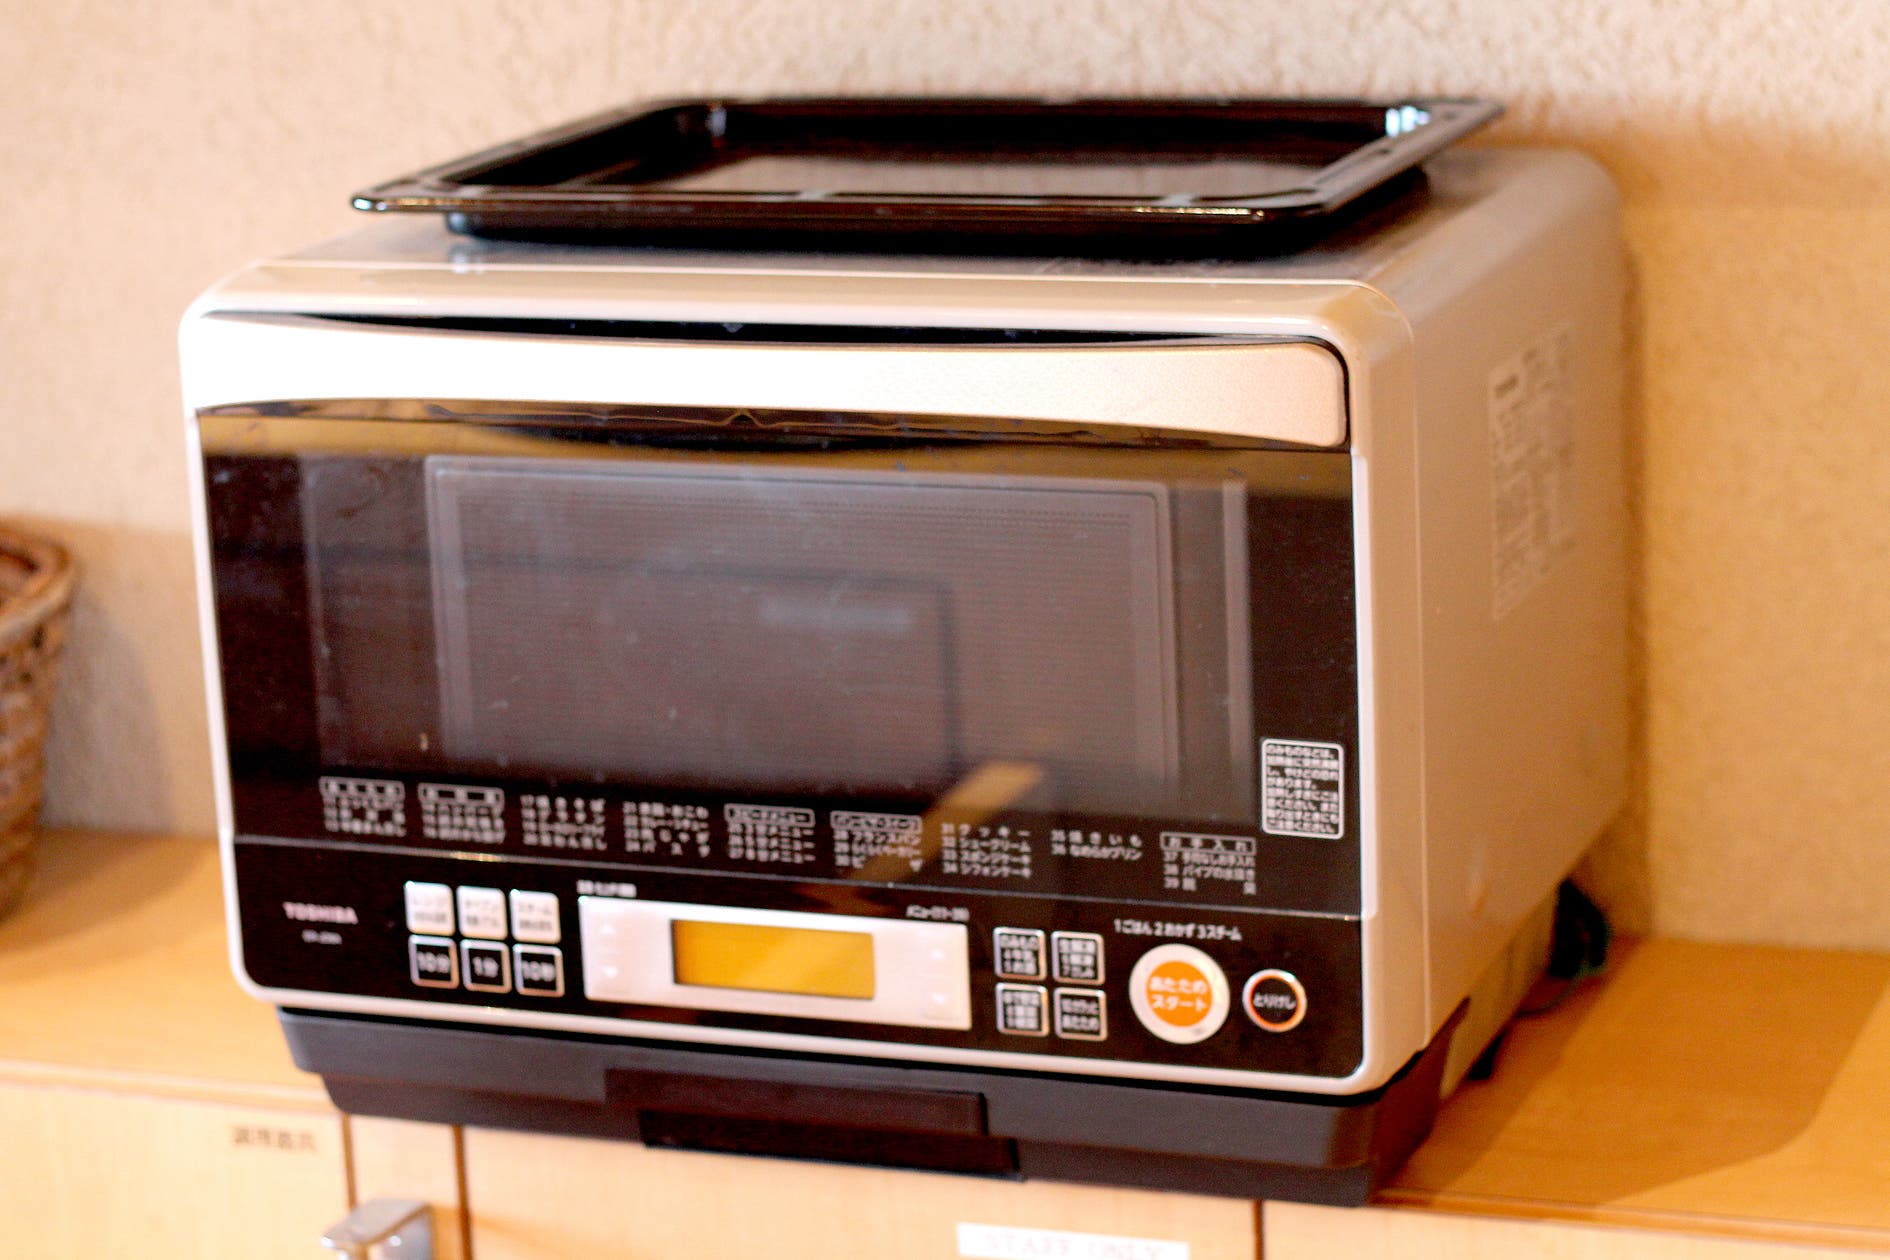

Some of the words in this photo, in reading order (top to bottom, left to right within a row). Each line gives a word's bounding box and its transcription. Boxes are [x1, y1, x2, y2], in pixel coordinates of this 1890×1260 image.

[282, 901, 359, 925] TOSHIBA
[1149, 975, 1210, 995] あたため
[1150, 993, 1209, 1013] スタート
[1252, 992, 1297, 1011] とりけし
